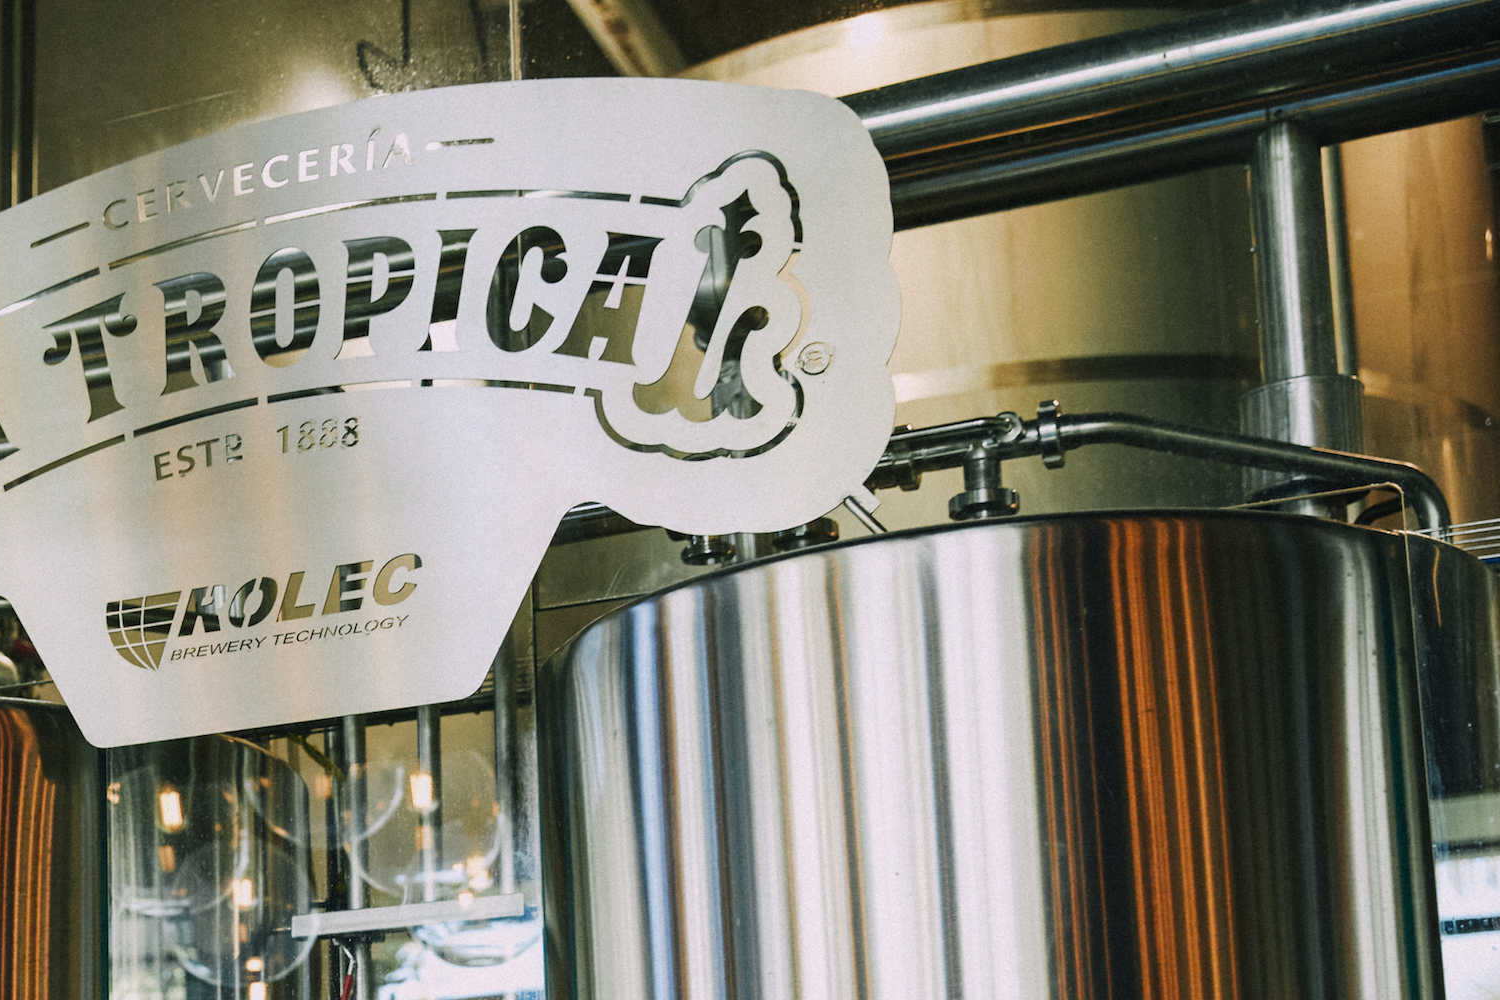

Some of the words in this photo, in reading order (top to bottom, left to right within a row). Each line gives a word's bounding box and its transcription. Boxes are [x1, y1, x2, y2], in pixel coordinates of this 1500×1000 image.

[102, 126, 413, 230] CERVECERÍA
[43, 188, 770, 424] TROPICAL
[276, 417, 360, 454] 1888
[177, 553, 423, 637] KOLEC
[170, 636, 267, 662] BREWERY
[273, 614, 409, 647] TECHNOLOGY
